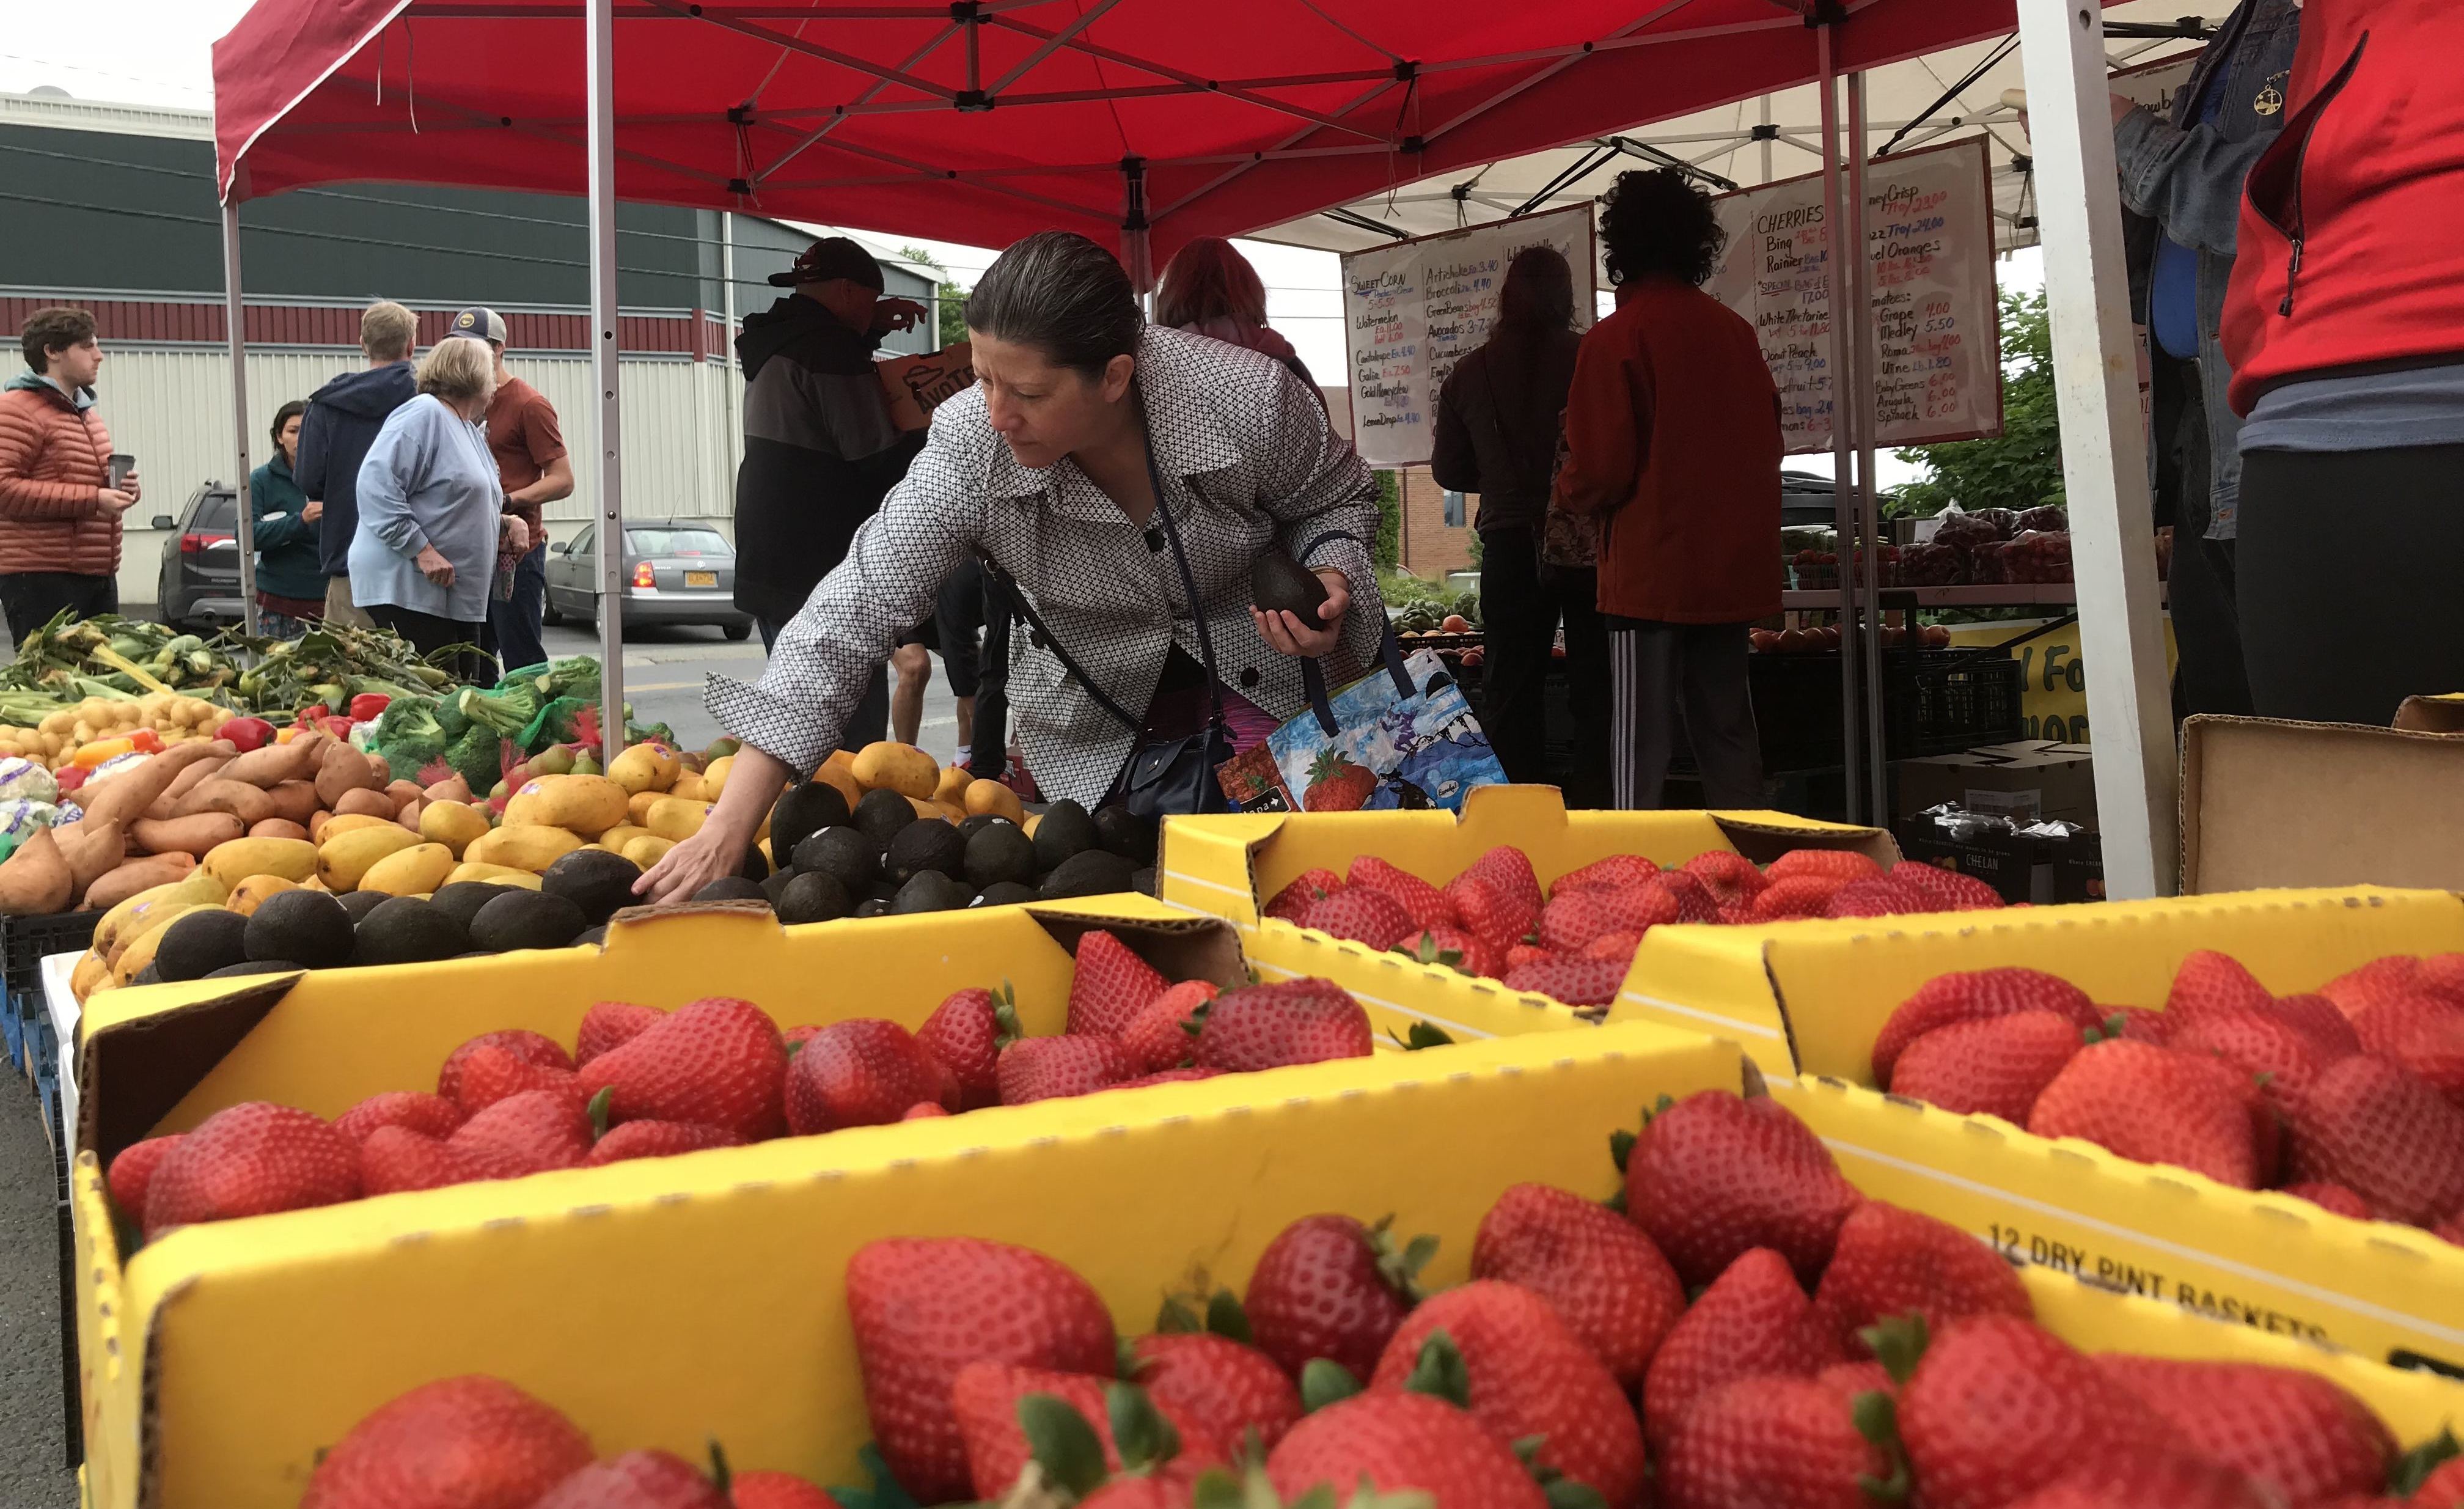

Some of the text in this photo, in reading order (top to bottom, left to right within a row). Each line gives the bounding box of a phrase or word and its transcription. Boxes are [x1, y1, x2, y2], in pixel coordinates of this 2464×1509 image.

[1888, 184, 1919, 207] Crisp
[1757, 205, 1825, 234] CHERRIES
[1767, 236, 1792, 258] Bing
[1888, 242, 1941, 259] Oranges
[1426, 263, 1470, 285] Artichoke
[1767, 255, 1804, 273] Rainier
[1380, 271, 1406, 287] CORN
[1426, 281, 1461, 301] Broccoli
[1871, 290, 1912, 308] matoes:
[1356, 309, 1398, 330] Watermelon
[1759, 307, 1831, 327] White Nectarine
[1880, 302, 1951, 324] Grape 4.00
[1427, 320, 1465, 339] Avocados
[1880, 317, 1954, 342] Medley 5.50
[1429, 344, 1473, 361] Cucumbers
[1760, 342, 1817, 362] Donut Peach
[1881, 343, 1911, 359] Roma
[1805, 358, 1827, 371] 9.00
[1882, 361, 1911, 375] Vine
[1895, 376, 1926, 392] Greens
[1929, 372, 1956, 387] 6.00
[1876, 387, 1956, 408] Arugula 6.00
[1795, 402, 1812, 419] bag
[1876, 402, 1956, 427] Spinach 6.00
[1966, 853, 1998, 870] CHELAN
[1988, 1223, 2020, 1257] 12
[2030, 1233, 2086, 1274] DRY
[2097, 1255, 2166, 1300] PINT
